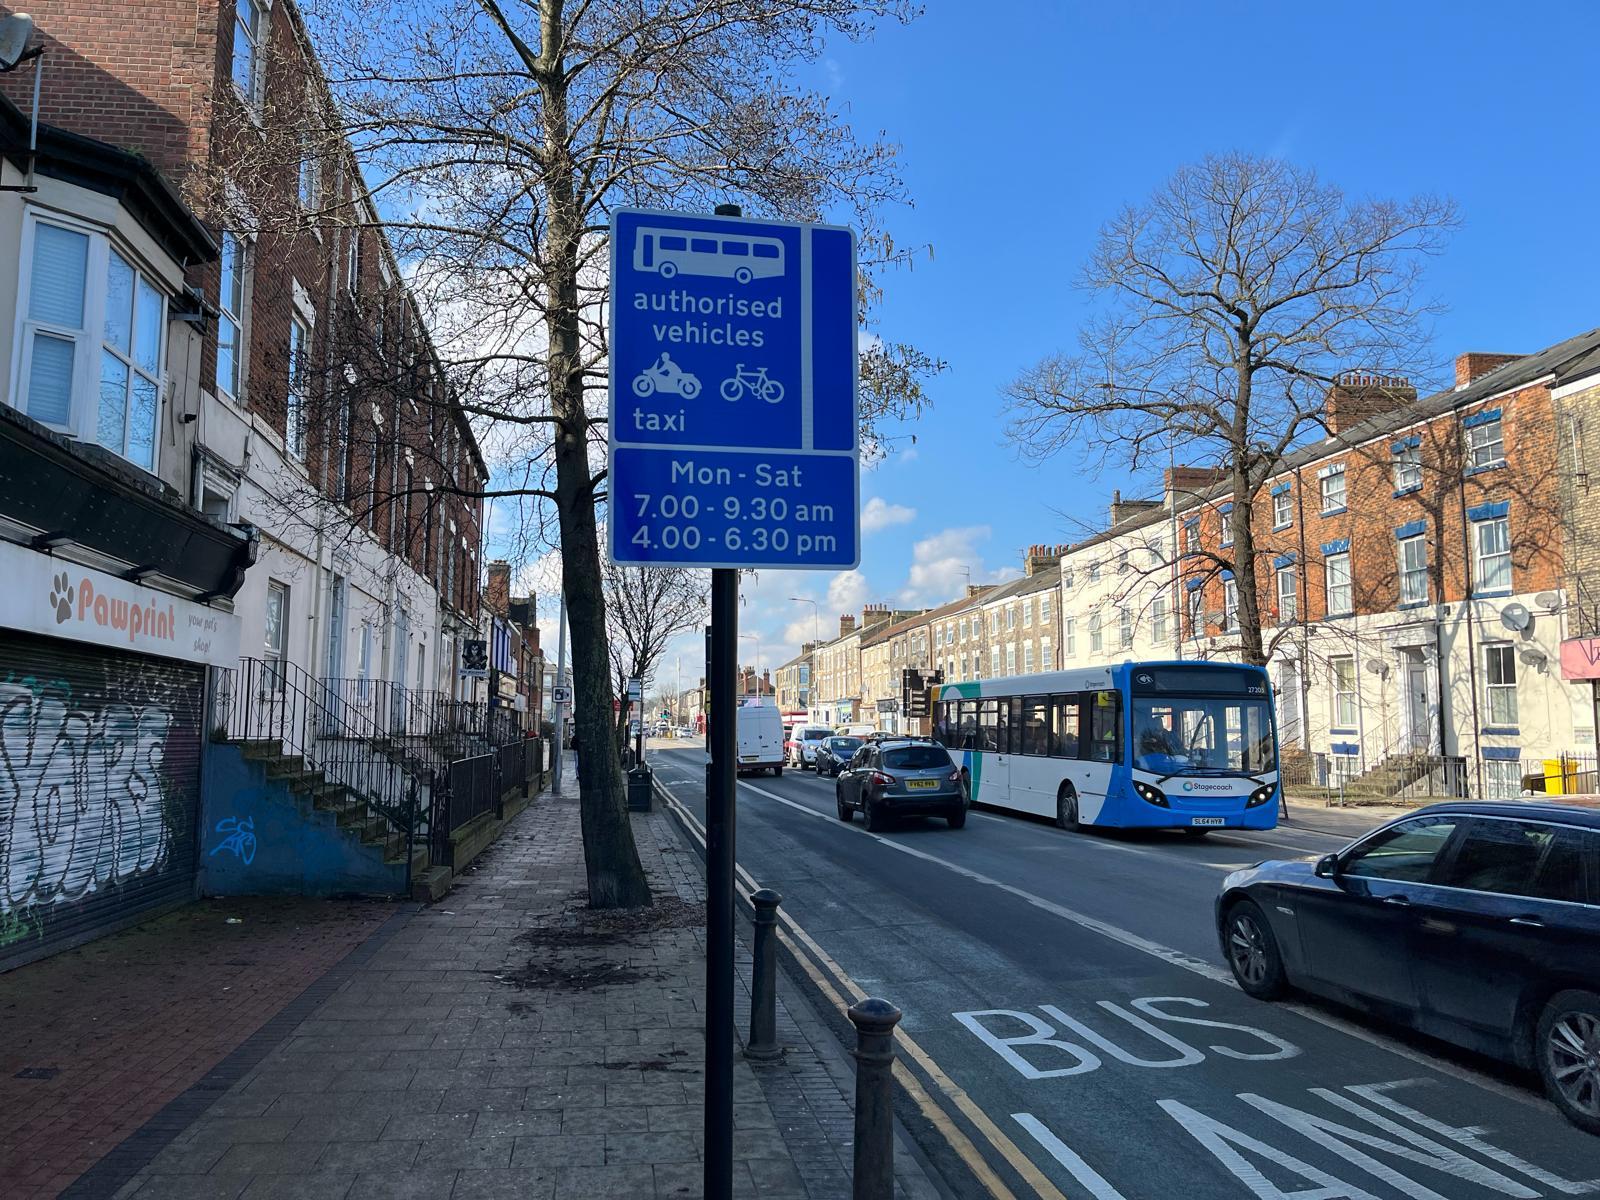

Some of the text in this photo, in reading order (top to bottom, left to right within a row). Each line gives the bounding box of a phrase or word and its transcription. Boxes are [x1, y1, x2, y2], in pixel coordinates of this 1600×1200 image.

[634, 290, 783, 319] authorised
[653, 321, 765, 348] vehicles
[633, 408, 686, 432] taxi
[671, 461, 731, 485] Mon
[755, 464, 802, 487] Sat
[634, 494, 699, 519] 7.00
[723, 497, 788, 521] 9.30
[795, 502, 834, 522] am
[631, 525, 701, 550] 4.00
[724, 527, 789, 551] 6.30
[797, 532, 837, 556] pm
[78, 578, 175, 642] Pawprint
[188, 613, 203, 628] your
[193, 637, 212, 655] shop!
[1193, 783, 1233, 791] Stagecoach
[952, 996, 1302, 1080] BUS
